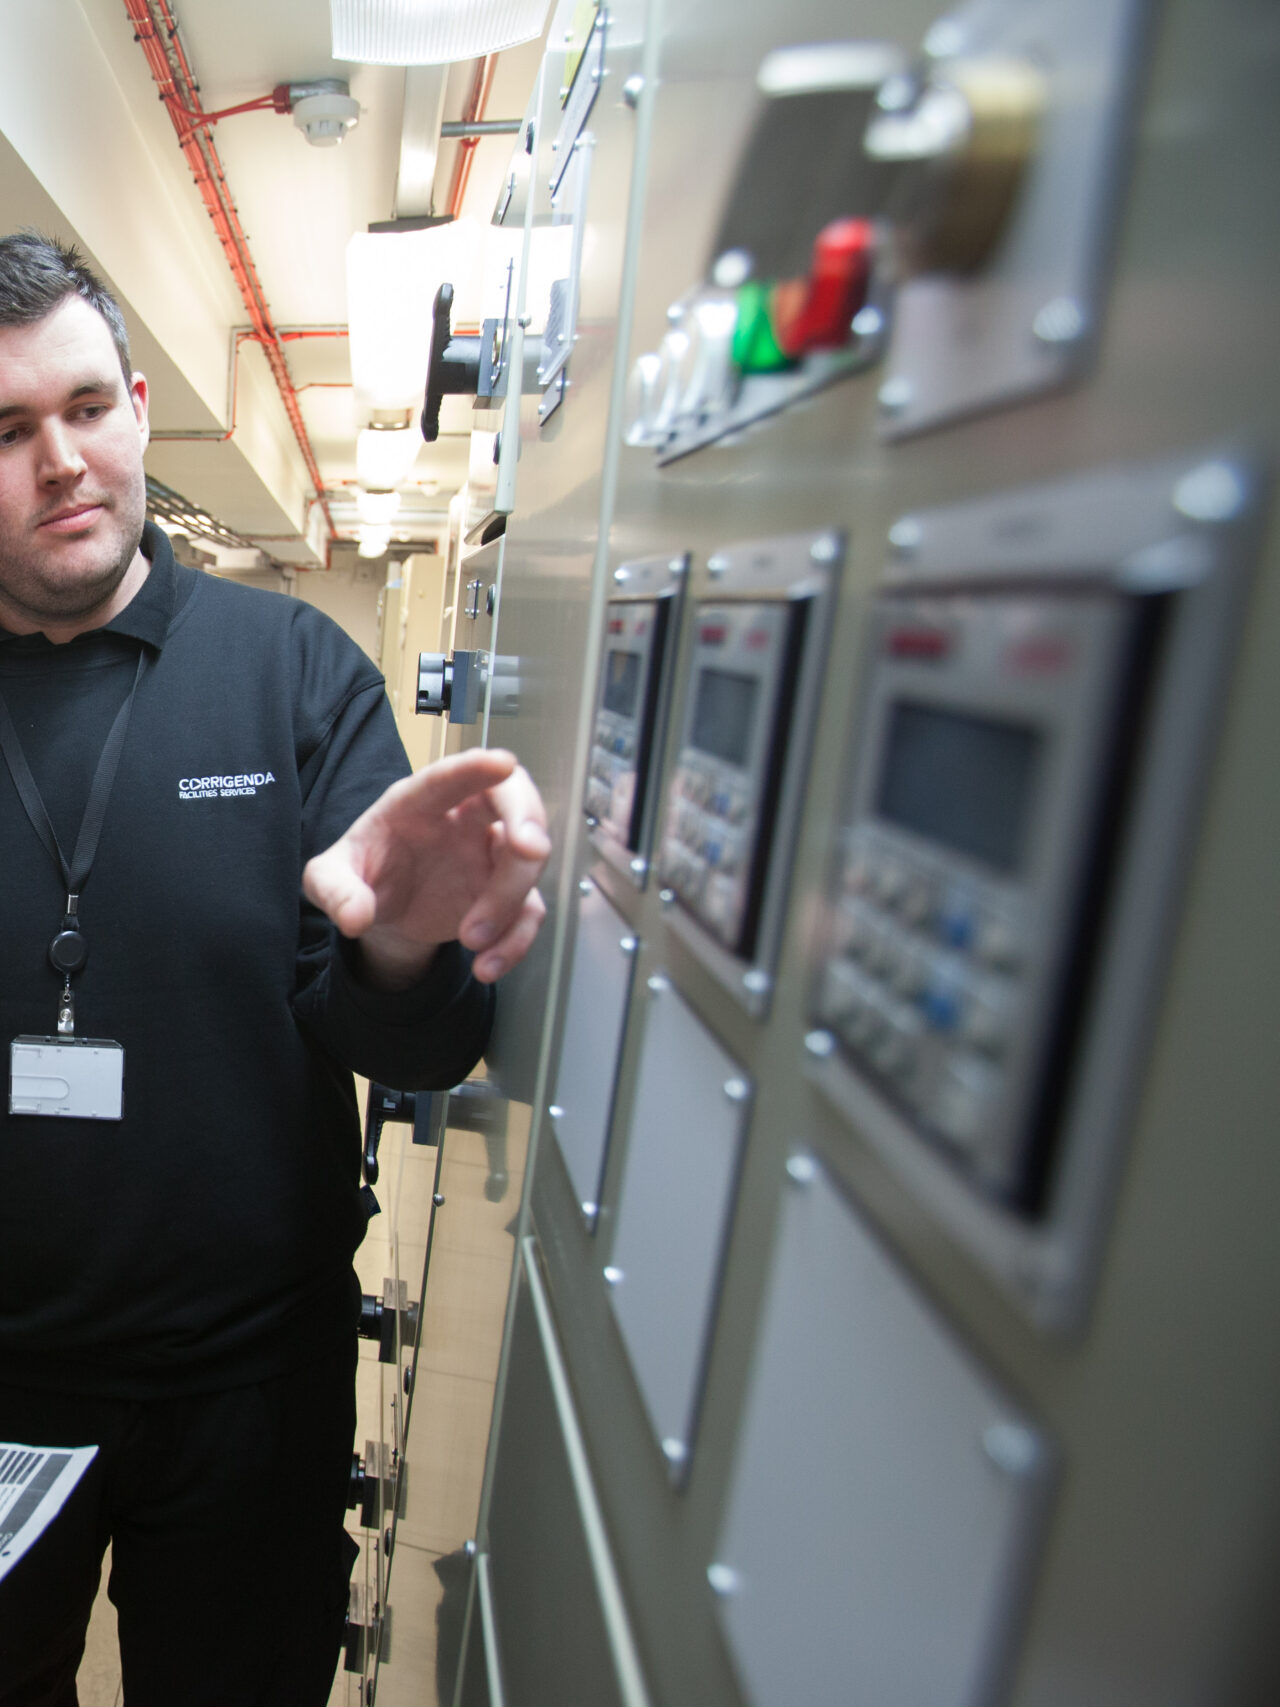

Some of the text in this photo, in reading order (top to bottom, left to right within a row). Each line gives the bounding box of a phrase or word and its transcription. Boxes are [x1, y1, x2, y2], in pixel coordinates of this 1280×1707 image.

[179, 772, 276, 791] CORRIGENDA
[179, 787, 256, 799] FACILITIES SERVICES
